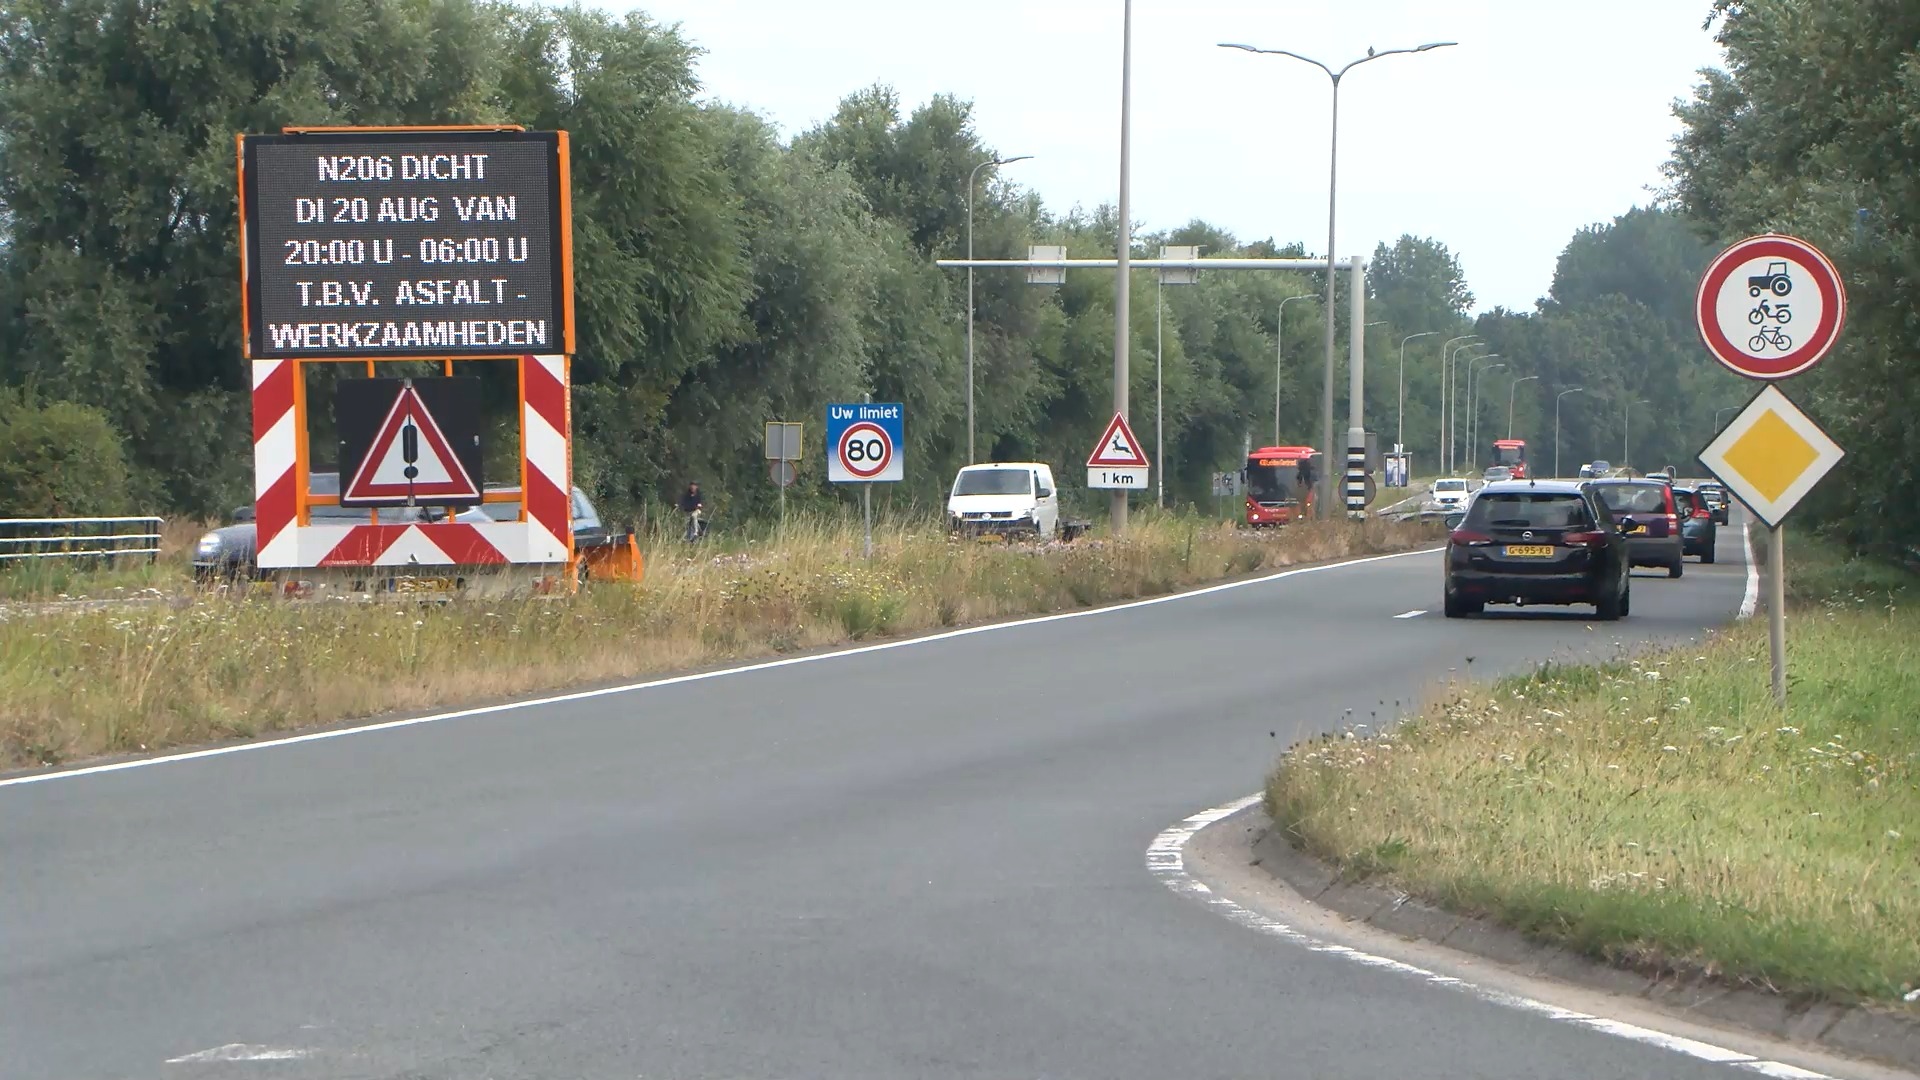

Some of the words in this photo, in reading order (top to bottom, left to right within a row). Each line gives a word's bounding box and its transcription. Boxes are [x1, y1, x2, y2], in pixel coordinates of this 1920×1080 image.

[318, 156, 392, 181] N206
[402, 155, 488, 179] DICHT
[297, 198, 324, 222] DI
[333, 198, 368, 222] 20
[378, 197, 438, 222] AUG
[453, 196, 515, 221] VAN
[285, 240, 364, 264] 20:00
[373, 239, 393, 263] U
[420, 238, 499, 263] 06:00
[508, 238, 527, 262] U
[297, 281, 379, 306] T.B.V.
[396, 279, 507, 304] ASFALT
[269, 320, 545, 348] WERKZAAMHEDEN
[832, 407, 854, 420] Uw
[859, 406, 899, 419] limiet
[847, 439, 884, 462] 80
[1102, 472, 1107, 484] 1
[1112, 472, 1134, 484] km
